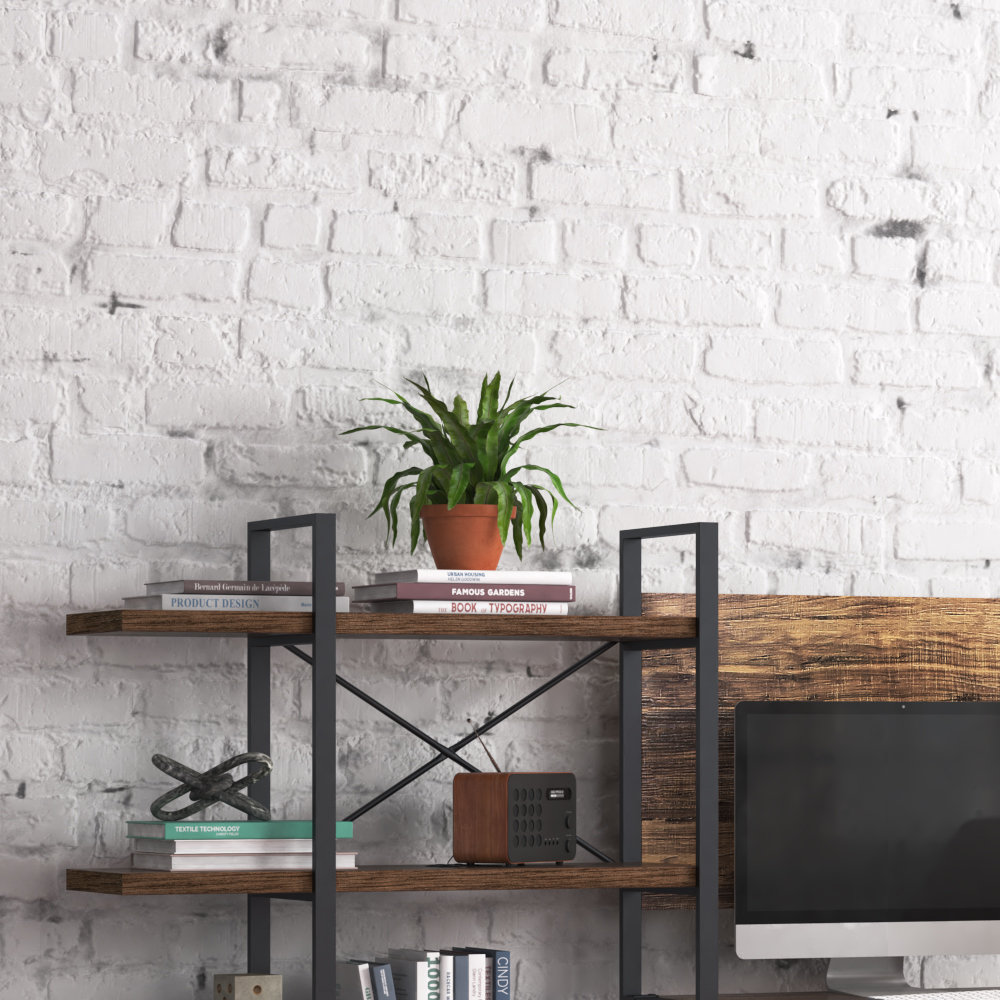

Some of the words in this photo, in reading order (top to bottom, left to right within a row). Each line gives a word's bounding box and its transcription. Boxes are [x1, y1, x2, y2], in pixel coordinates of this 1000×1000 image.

[194, 582, 221, 592] Bernard
[222, 583, 250, 592] Germain
[251, 583, 260, 593] de
[451, 588, 485, 597] FAMOUS
[487, 588, 525, 597] GARDENS
[171, 597, 221, 608] PRODUCT
[222, 598, 260, 609] DESIGN
[451, 602, 477, 613] BOOK
[489, 603, 548, 614] TYPOGRAPHY
[175, 825, 198, 833] TEXTILE
[199, 825, 241, 833] TECHNOLOGY
[497, 956, 509, 995] CINDY
